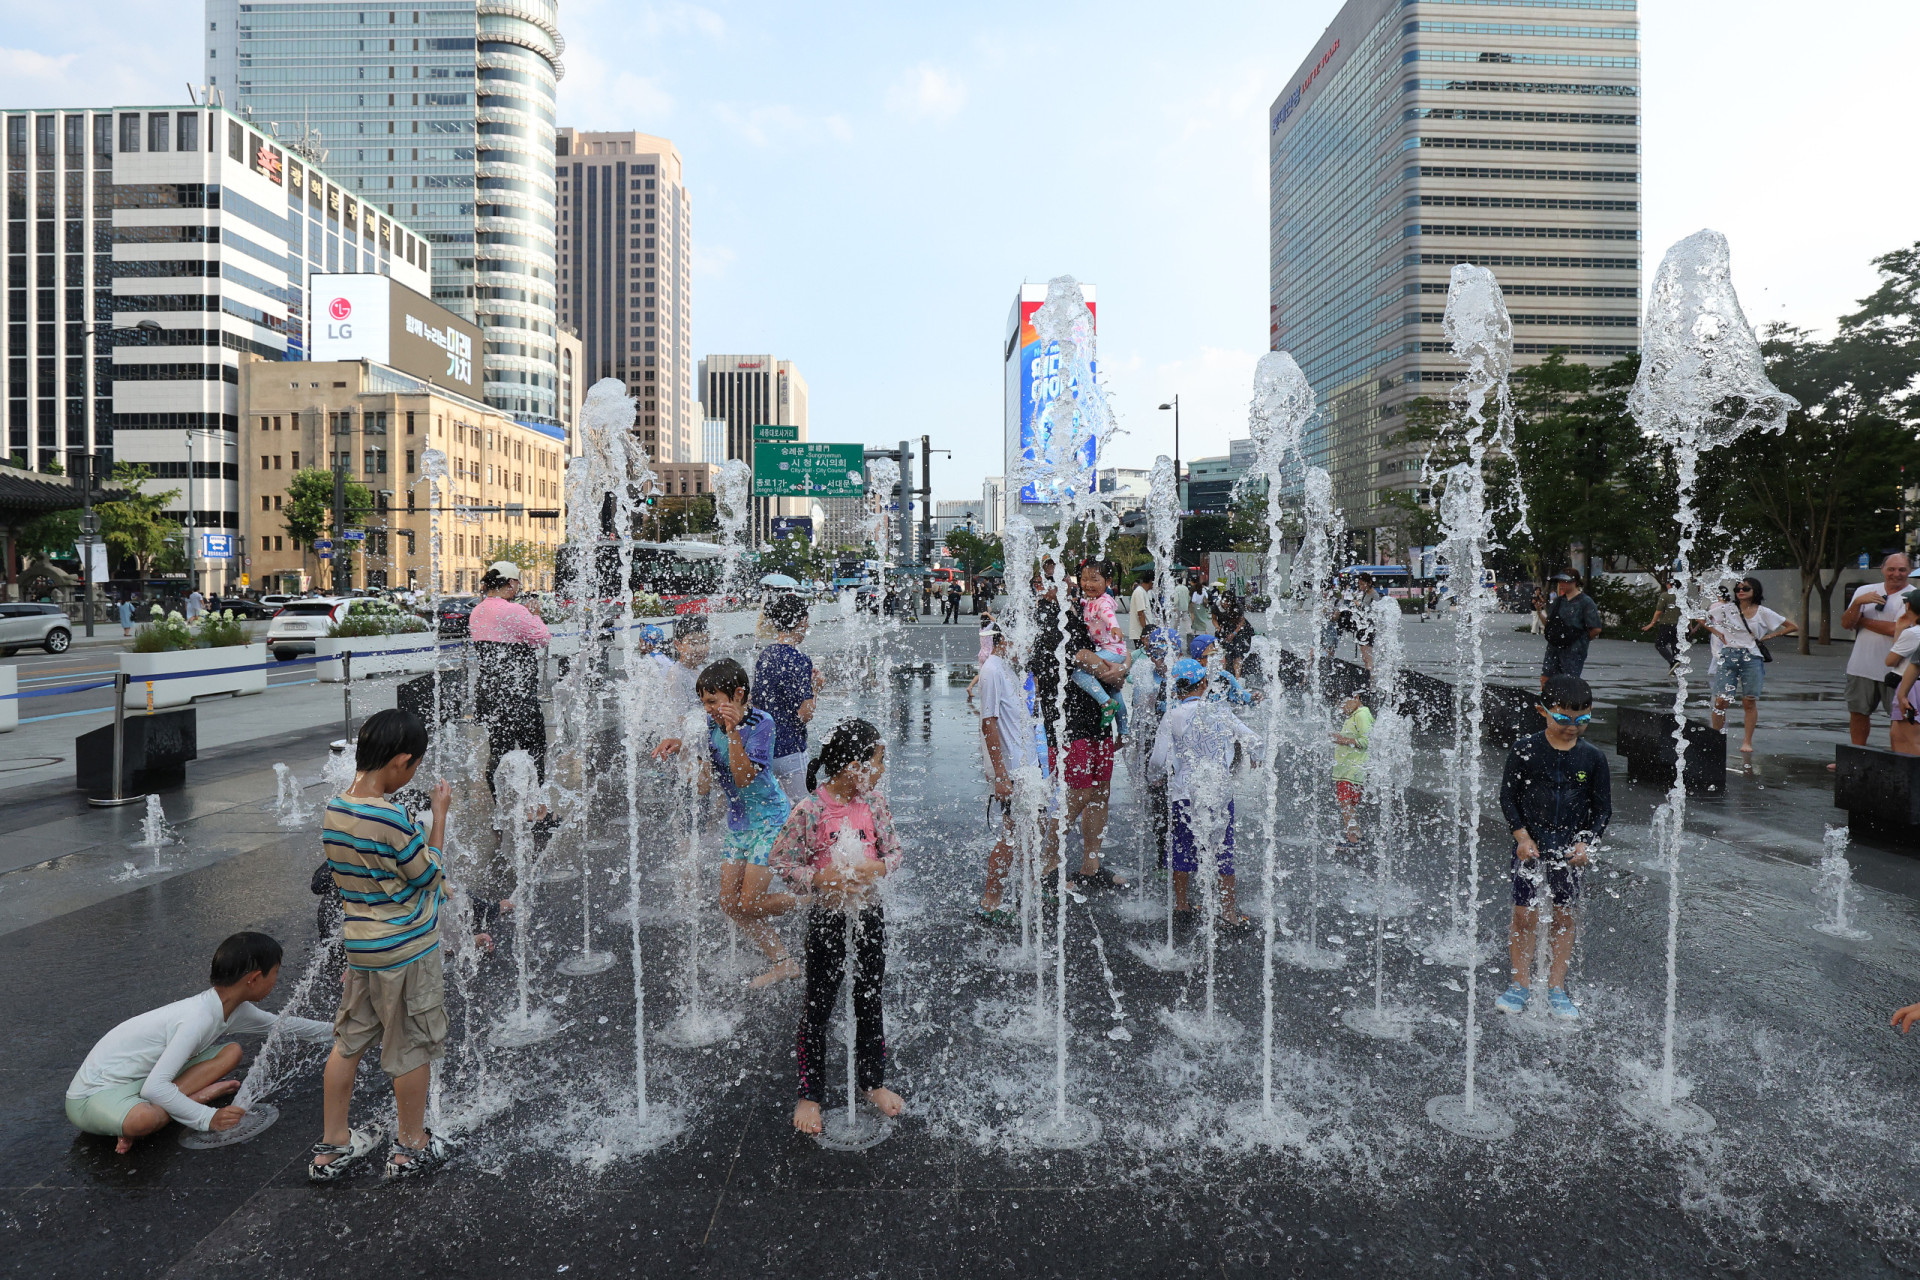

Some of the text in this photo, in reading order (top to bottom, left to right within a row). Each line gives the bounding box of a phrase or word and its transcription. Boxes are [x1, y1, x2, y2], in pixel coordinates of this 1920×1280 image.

[1320, 37, 1340, 69] TOUR
[327, 323, 353, 340] LG
[446, 325, 472, 361] 미래
[446, 352, 472, 386] 가치
[759, 428, 794, 437] 세종대로사거리
[781, 447, 805, 456] 숭례문
